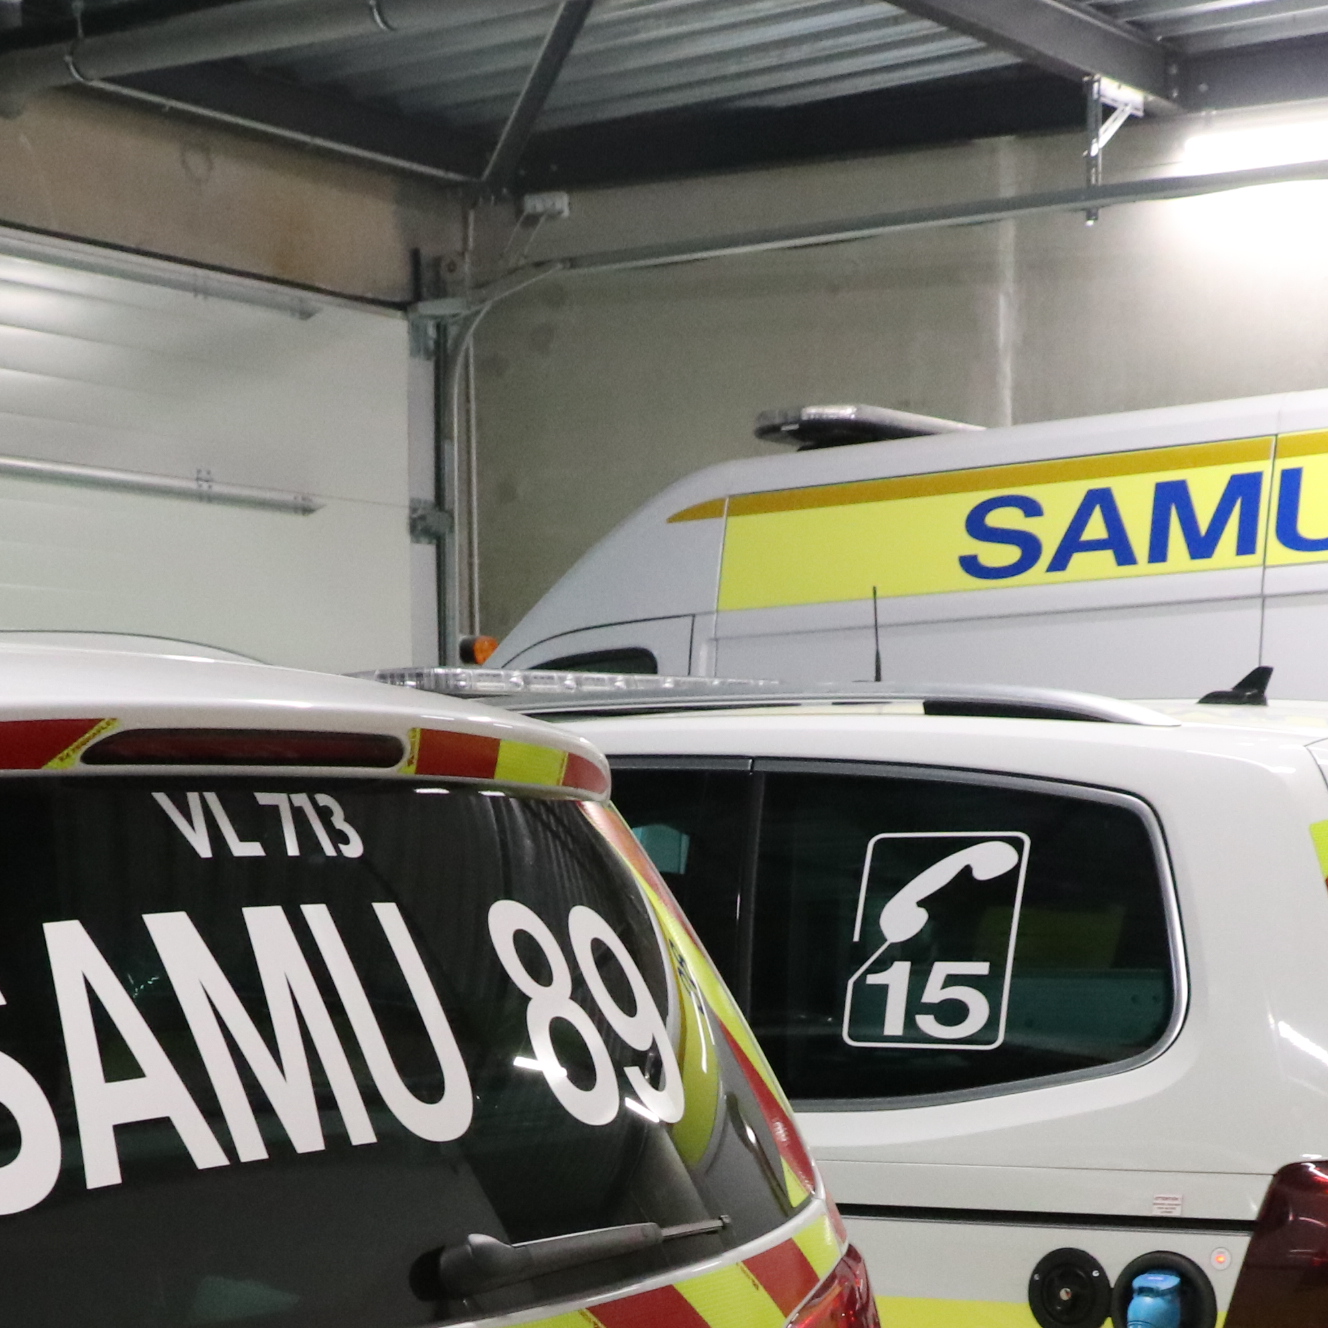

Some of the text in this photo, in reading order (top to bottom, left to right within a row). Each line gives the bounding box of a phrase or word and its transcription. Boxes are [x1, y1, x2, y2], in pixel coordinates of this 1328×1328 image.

[151, 791, 364, 859] VL 713
[488, 899, 684, 1126] 89
[865, 960, 990, 1040] 15
